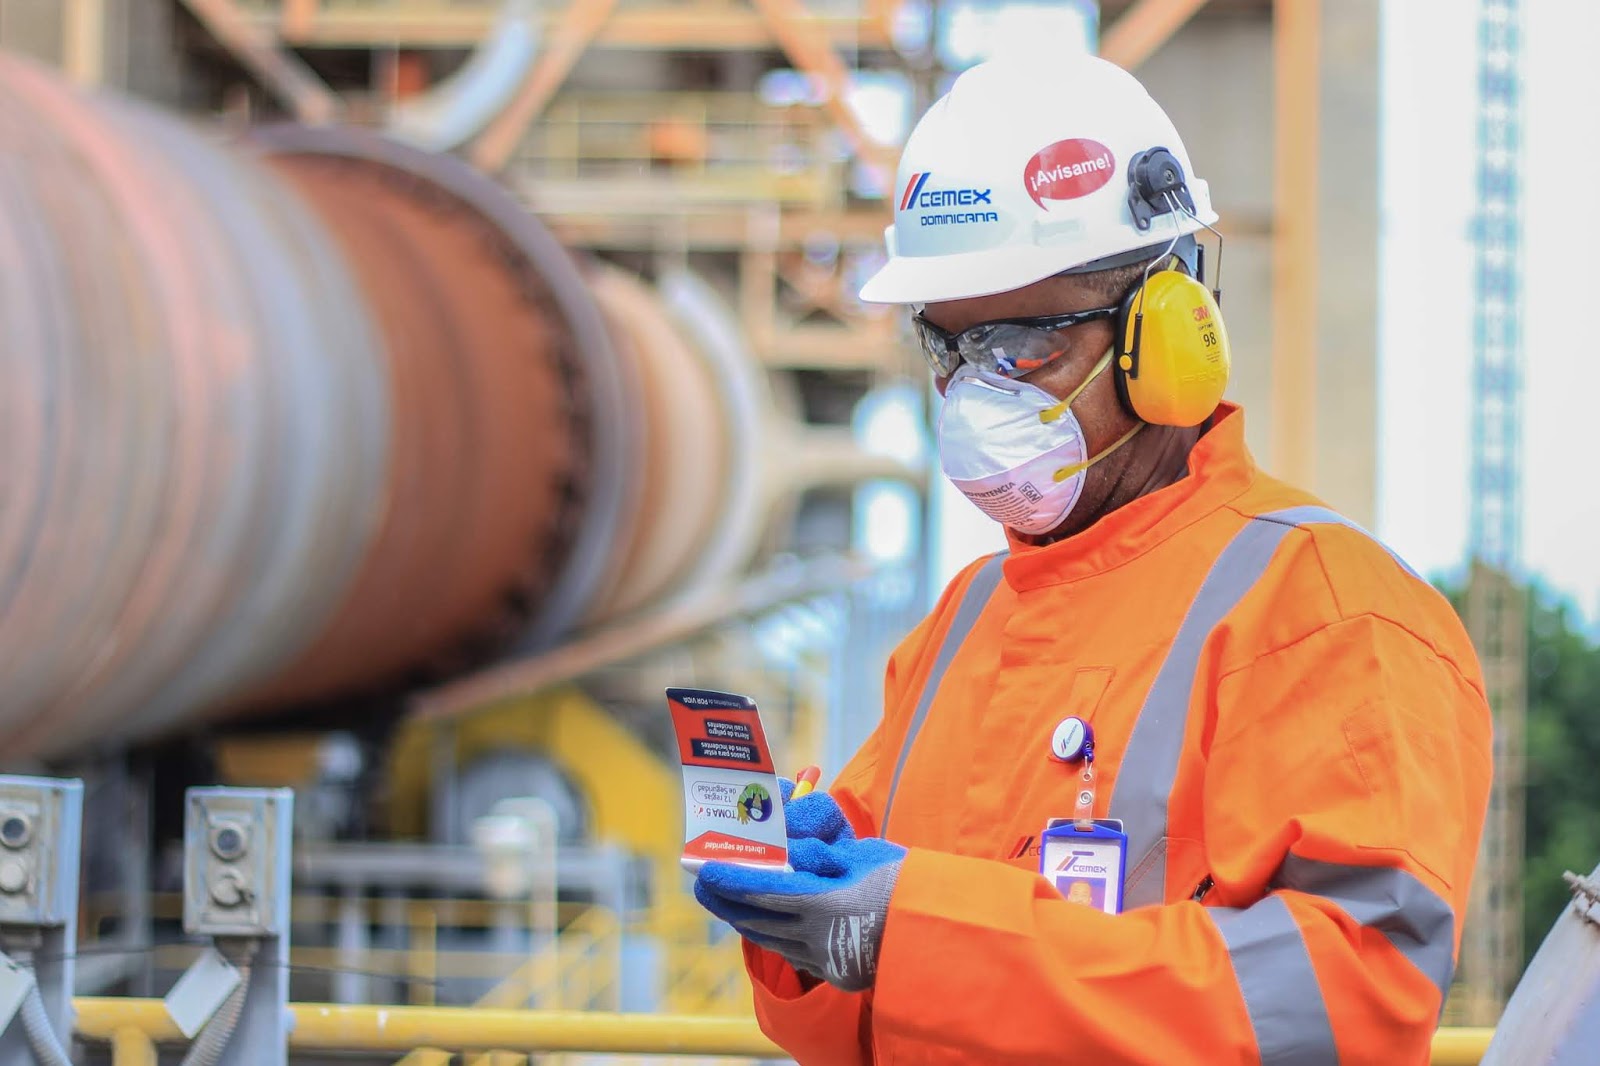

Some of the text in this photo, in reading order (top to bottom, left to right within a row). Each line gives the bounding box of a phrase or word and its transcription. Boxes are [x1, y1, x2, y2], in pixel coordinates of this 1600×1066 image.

[1030, 153, 1112, 191] ¡Avísame!
[920, 189, 992, 208] CEMEX
[921, 212, 998, 226] DOMINICANA
[1193, 305, 1210, 321] 3M
[1203, 332, 1217, 347] 98
[1022, 484, 1041, 501] N95
[698, 785, 737, 795] de Seguridad
[704, 793, 722, 801] reglas
[706, 807, 736, 819] TOMA 5
[704, 841, 735, 851] seguridad
[745, 846, 766, 855] Libreta
[1072, 864, 1107, 873] CEMEX
